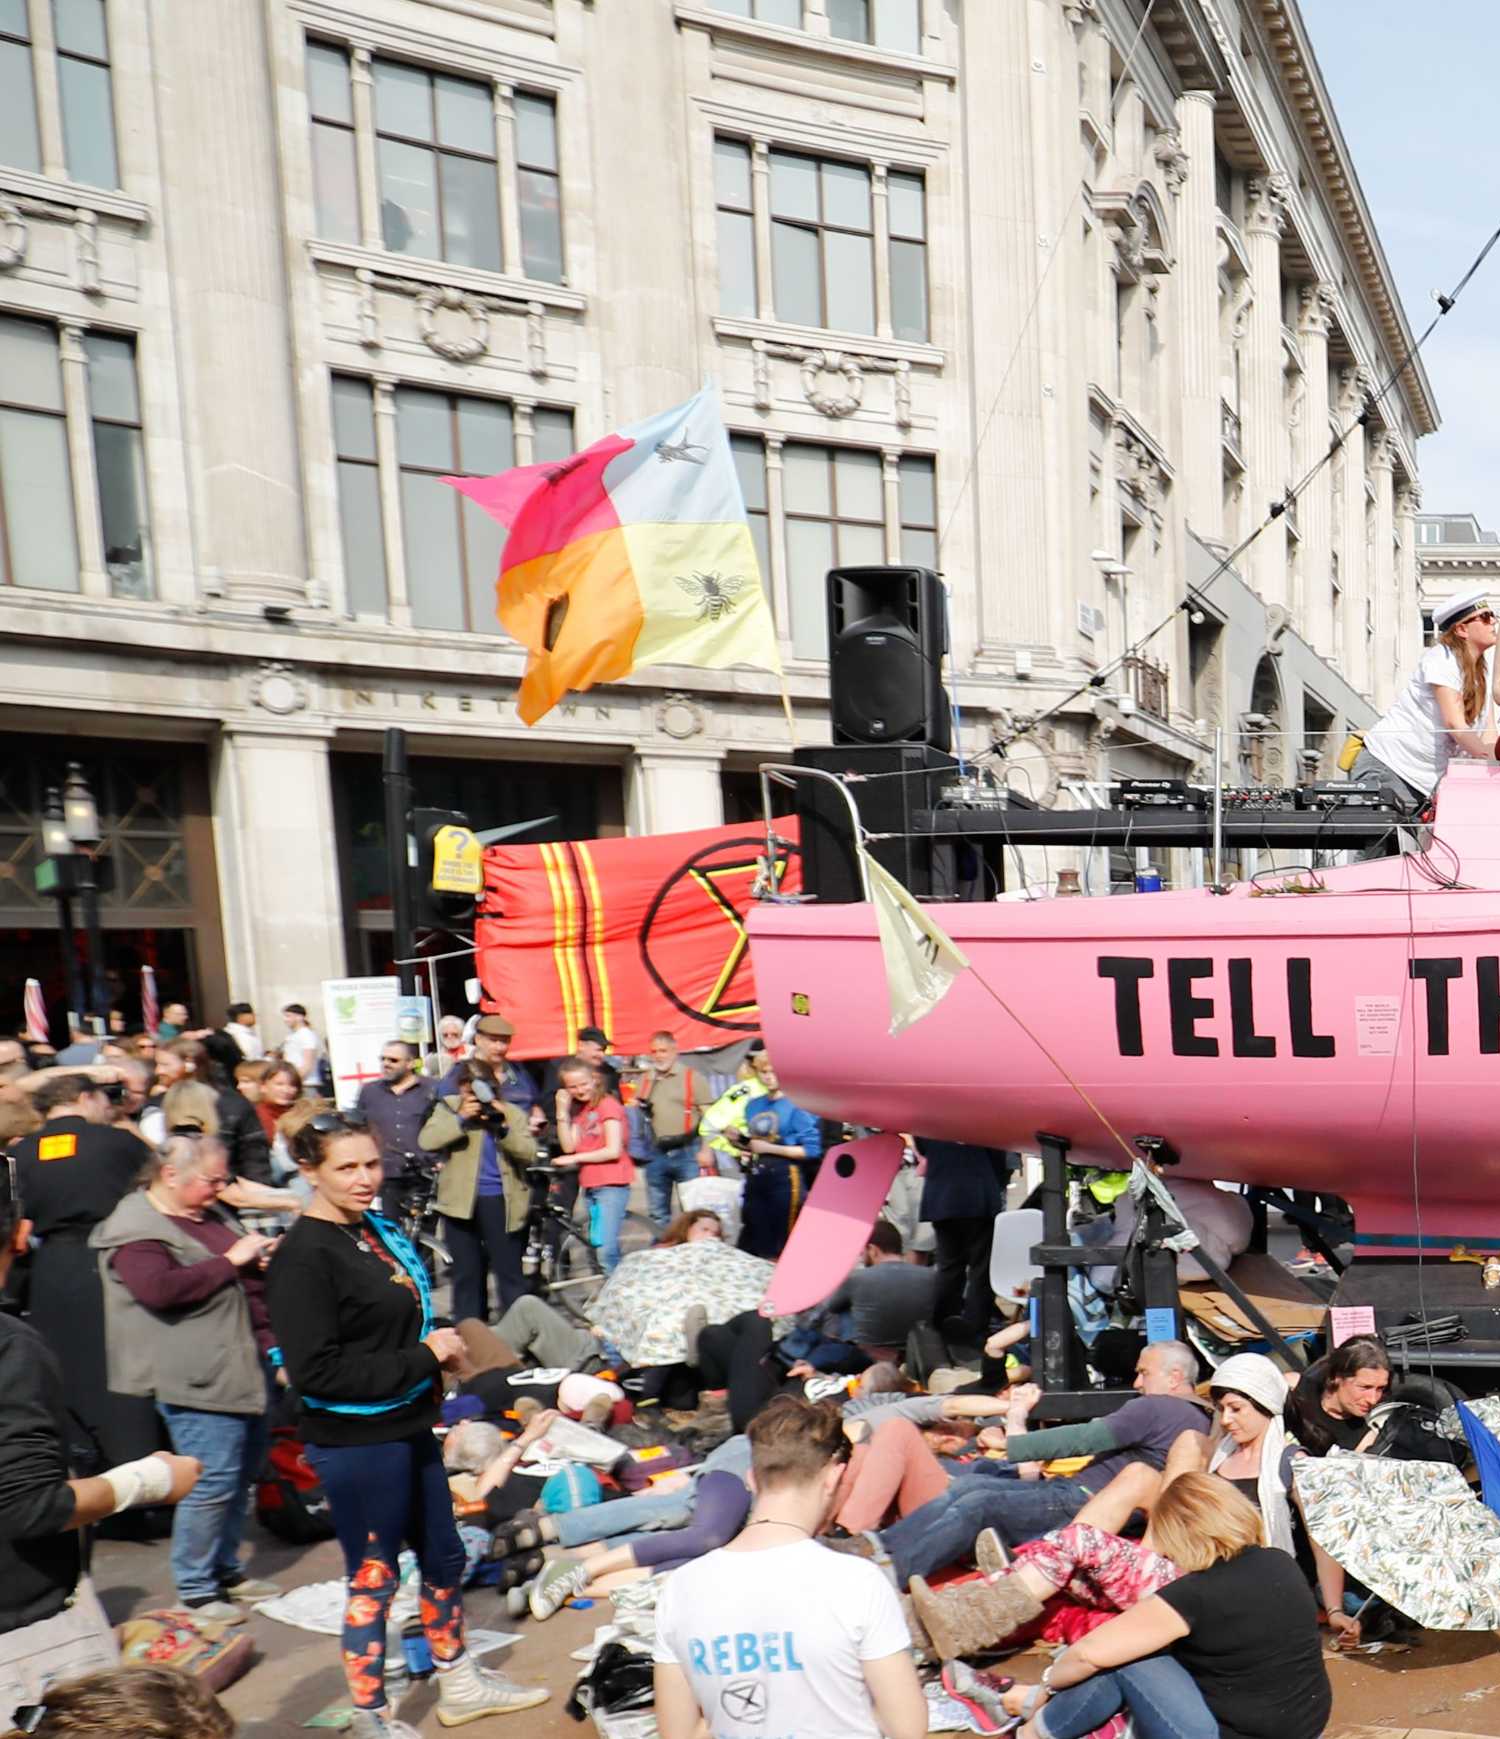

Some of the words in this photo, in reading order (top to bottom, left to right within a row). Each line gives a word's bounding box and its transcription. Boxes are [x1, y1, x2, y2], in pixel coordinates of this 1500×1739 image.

[354, 689, 612, 721] NIKETWN
[1098, 956, 1336, 1058] TELL
[688, 1631, 805, 1676] REBEL
